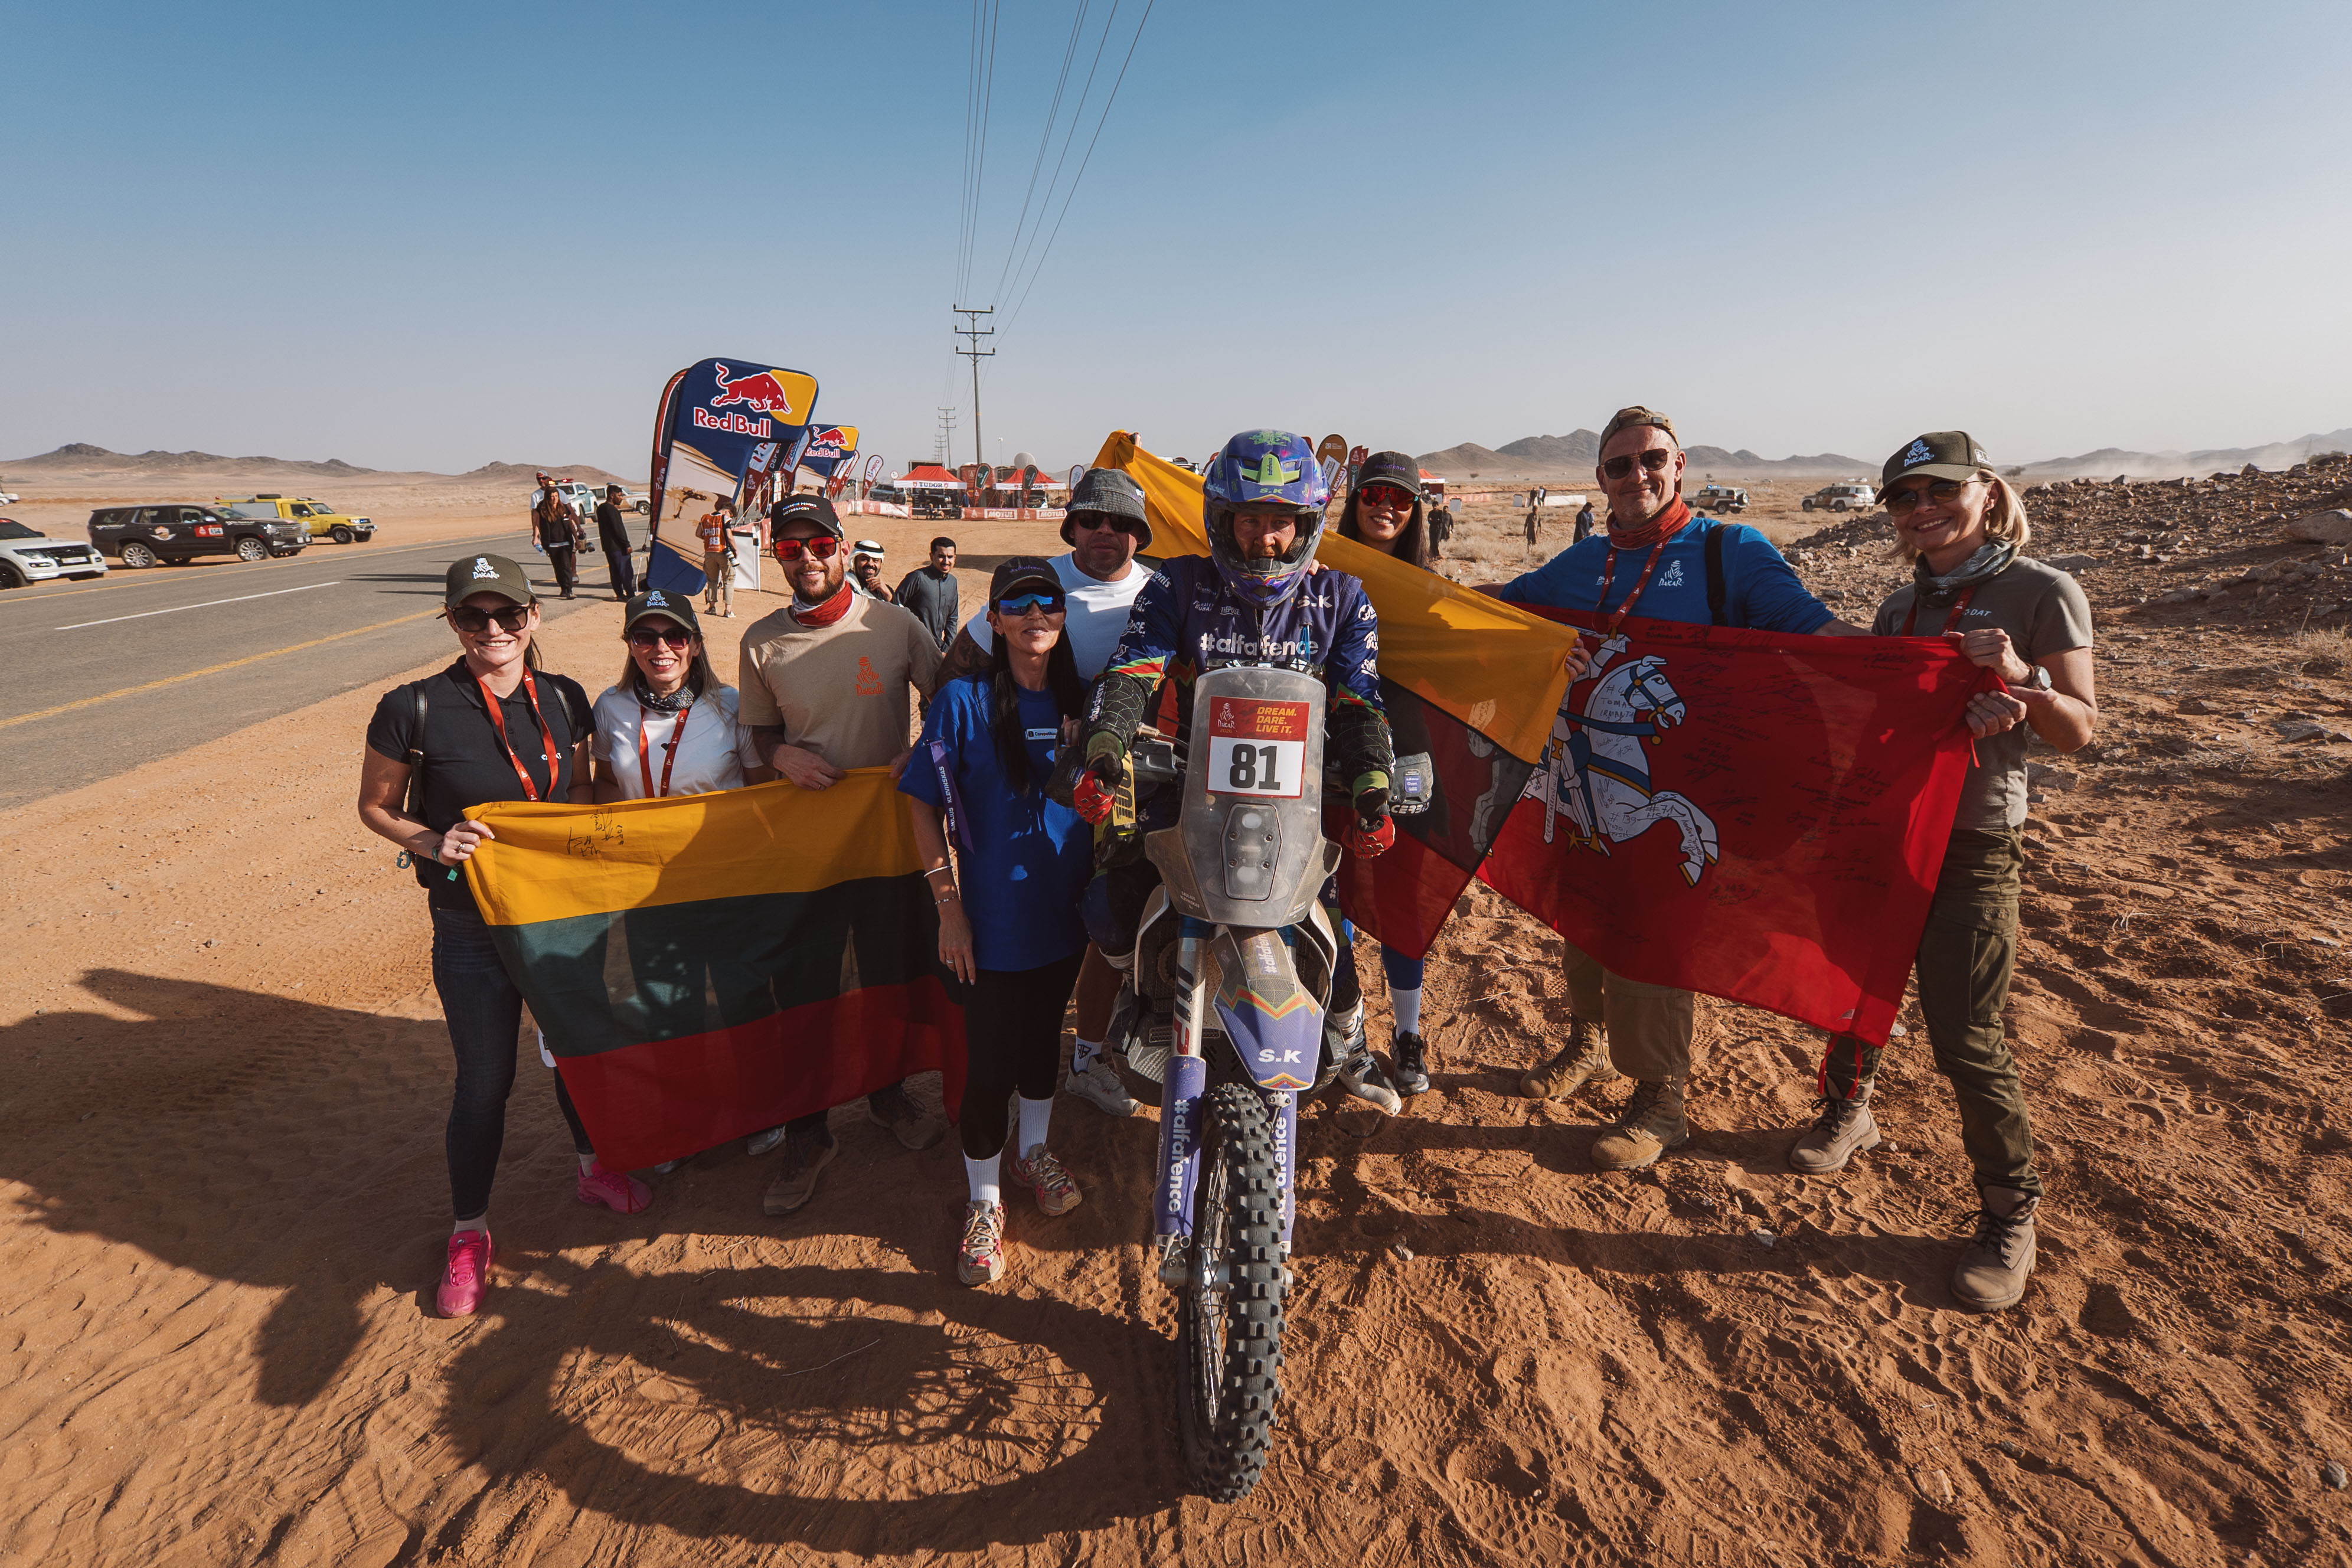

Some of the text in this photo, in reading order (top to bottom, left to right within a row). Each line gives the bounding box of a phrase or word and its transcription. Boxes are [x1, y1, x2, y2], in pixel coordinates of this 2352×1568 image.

[694, 407, 771, 439] Red Bull
[805, 447, 840, 458] Red Bull
[1904, 452, 1931, 467] DAKAR
[473, 570, 498, 579] DAKAR
[1658, 578, 1683, 586] DAKAR
[1296, 594, 1332, 609] S.K
[1200, 632, 1319, 656] #alfafence
[855, 682, 884, 697] DAKAR
[1257, 707, 1297, 716] DREAM.
[1217, 719, 1236, 729] DAKAR
[1256, 716, 1287, 724] DARE.
[1229, 744, 1280, 790] 81
[939, 766, 952, 803] KLEVINSKAS
[1258, 1048, 1302, 1064] S.K
[1168, 1099, 1190, 1214] #alfafence
